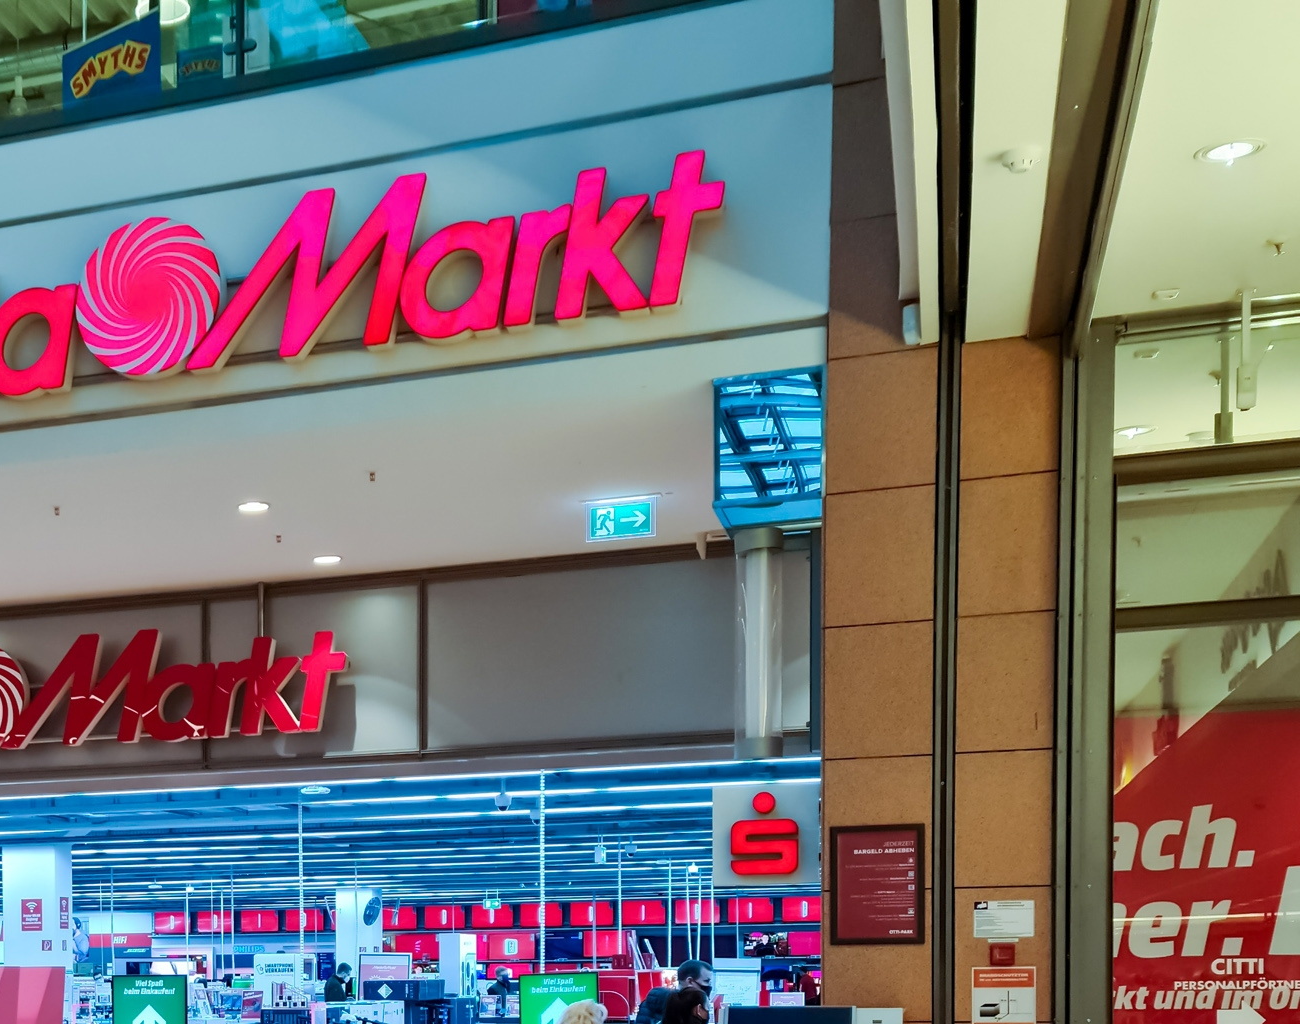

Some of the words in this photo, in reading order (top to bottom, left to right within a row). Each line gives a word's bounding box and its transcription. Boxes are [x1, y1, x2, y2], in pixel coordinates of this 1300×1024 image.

[71, 43, 150, 97] SMYTHS
[186, 149, 725, 374] Markt
[2, 628, 348, 750] Markt
[113, 935, 128, 944] HiFi
[1210, 958, 1265, 975] CITTI
[1113, 985, 1150, 1010] kt
[1153, 985, 1218, 1010] und
